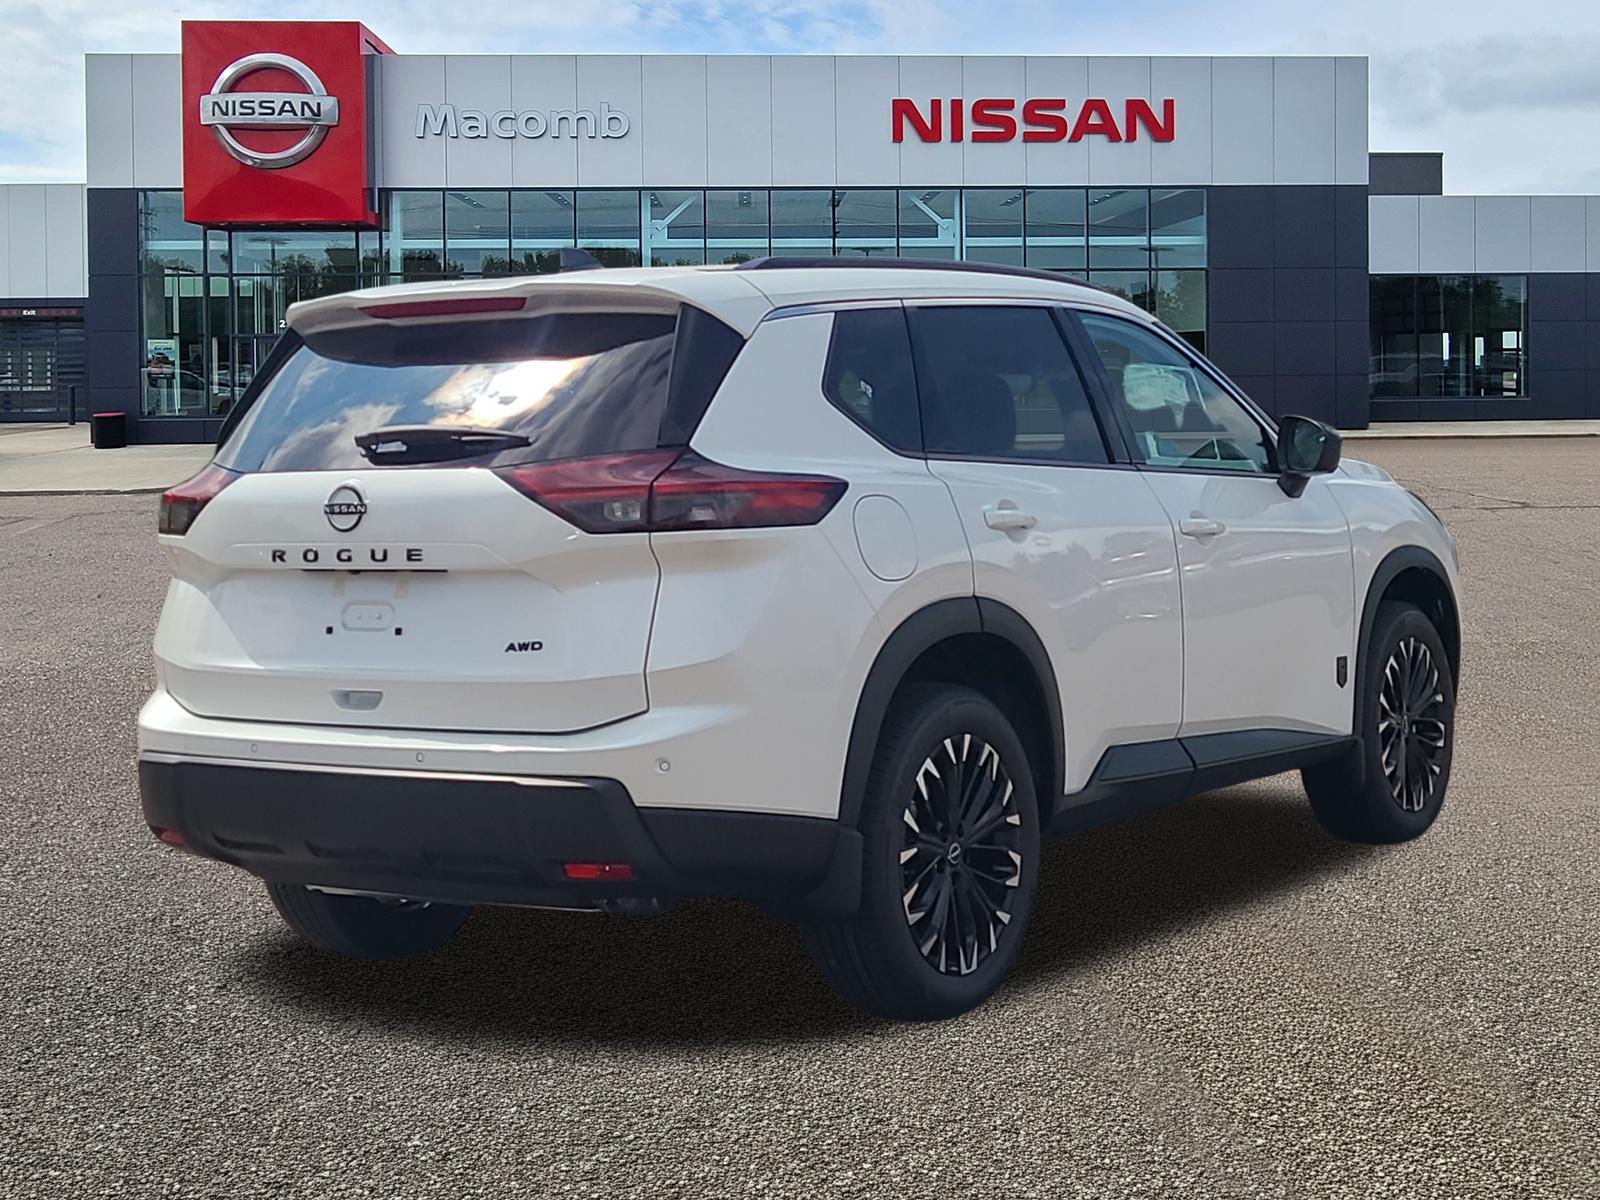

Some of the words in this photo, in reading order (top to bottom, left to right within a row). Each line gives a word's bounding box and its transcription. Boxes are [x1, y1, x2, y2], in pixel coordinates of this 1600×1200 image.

[211, 100, 322, 117] NISSAN
[415, 102, 630, 138] Macomb
[892, 98, 1175, 143] NISSAN
[324, 504, 366, 513] NISSAN
[271, 548, 424, 563] ROGUE
[504, 641, 543, 653] AWD
